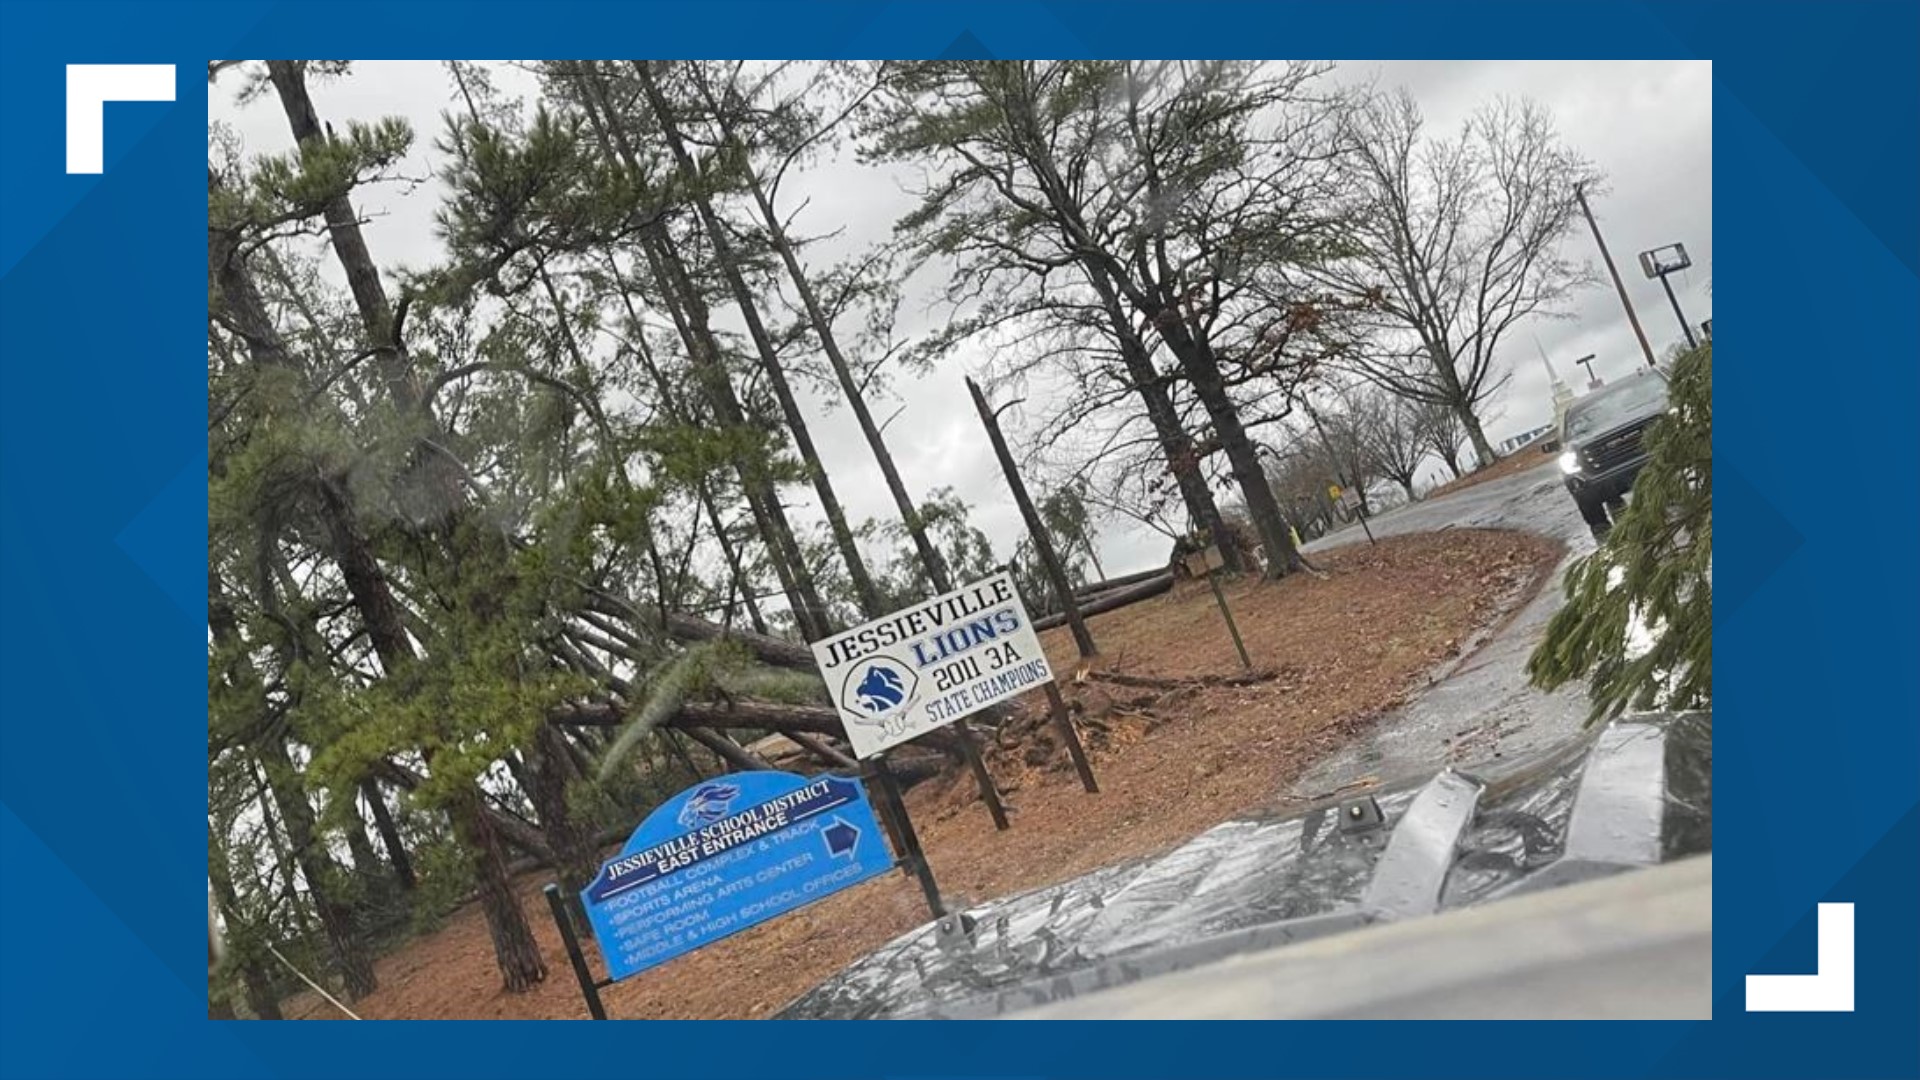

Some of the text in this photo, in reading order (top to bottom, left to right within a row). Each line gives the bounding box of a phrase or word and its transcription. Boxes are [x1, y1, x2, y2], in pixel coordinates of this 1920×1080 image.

[825, 578, 1013, 668] JESSIEVILLE
[911, 608, 1019, 669] LIONS
[925, 658, 1047, 722] STATE CHAMPIONS
[932, 641, 1022, 692] 2011 3A
[608, 780, 830, 880] JESSIEVILLE SCHOOL DISTRICT
[657, 811, 788, 874] EAST ENTRANCE
[685, 845, 755, 879] COMPLEX
[759, 840, 769, 851] &
[773, 820, 819, 844] TRACK
[674, 875, 722, 900] ARENA
[701, 913, 738, 935] HIGH
[740, 889, 801, 919] SCHOOL
[802, 862, 862, 893] OFFICES
[717, 875, 754, 898] ARTS
[756, 852, 813, 882] CENTER
[663, 909, 710, 935] ROOM
